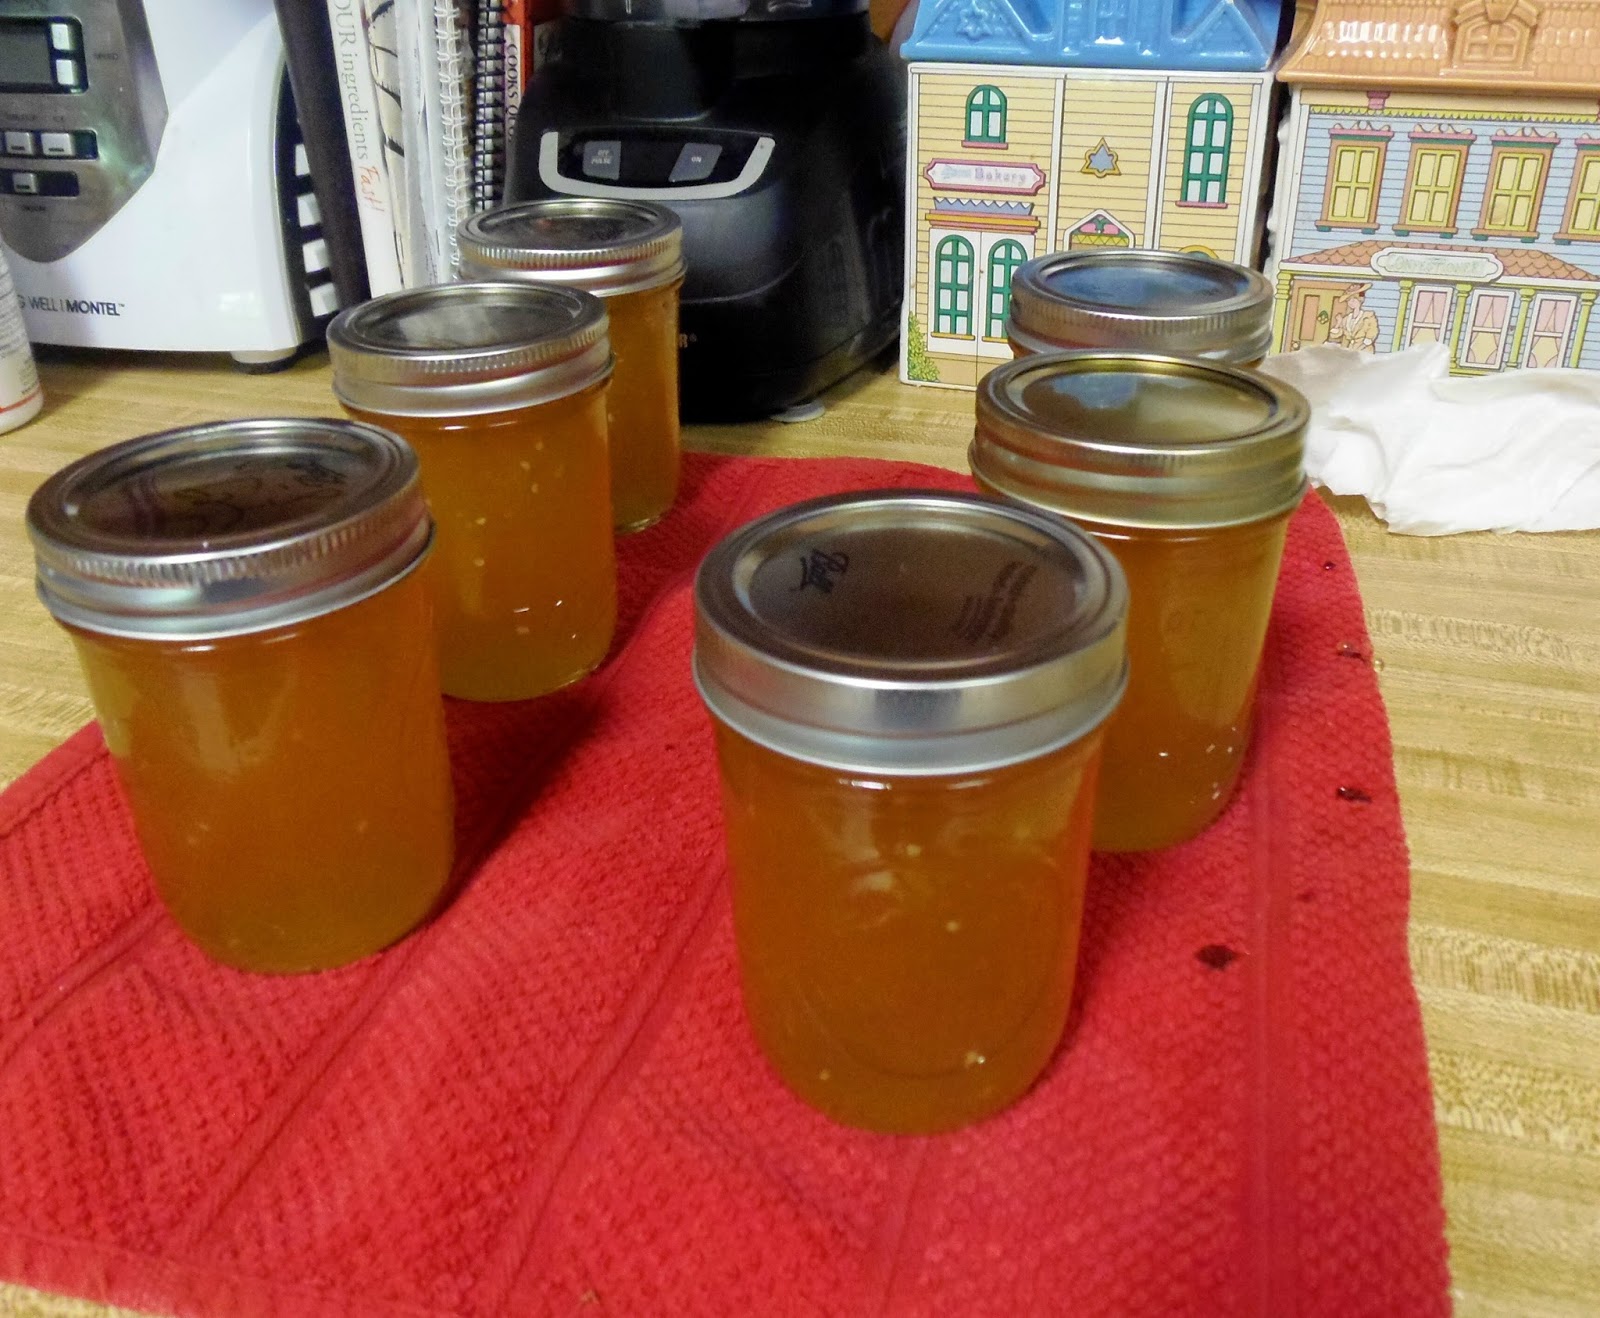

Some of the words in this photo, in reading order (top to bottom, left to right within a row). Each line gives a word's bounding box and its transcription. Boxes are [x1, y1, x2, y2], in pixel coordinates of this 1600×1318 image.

[507, 43, 518, 98] COOKS
[340, 53, 369, 160] ingredients
[28, 296, 58, 312] WELL
